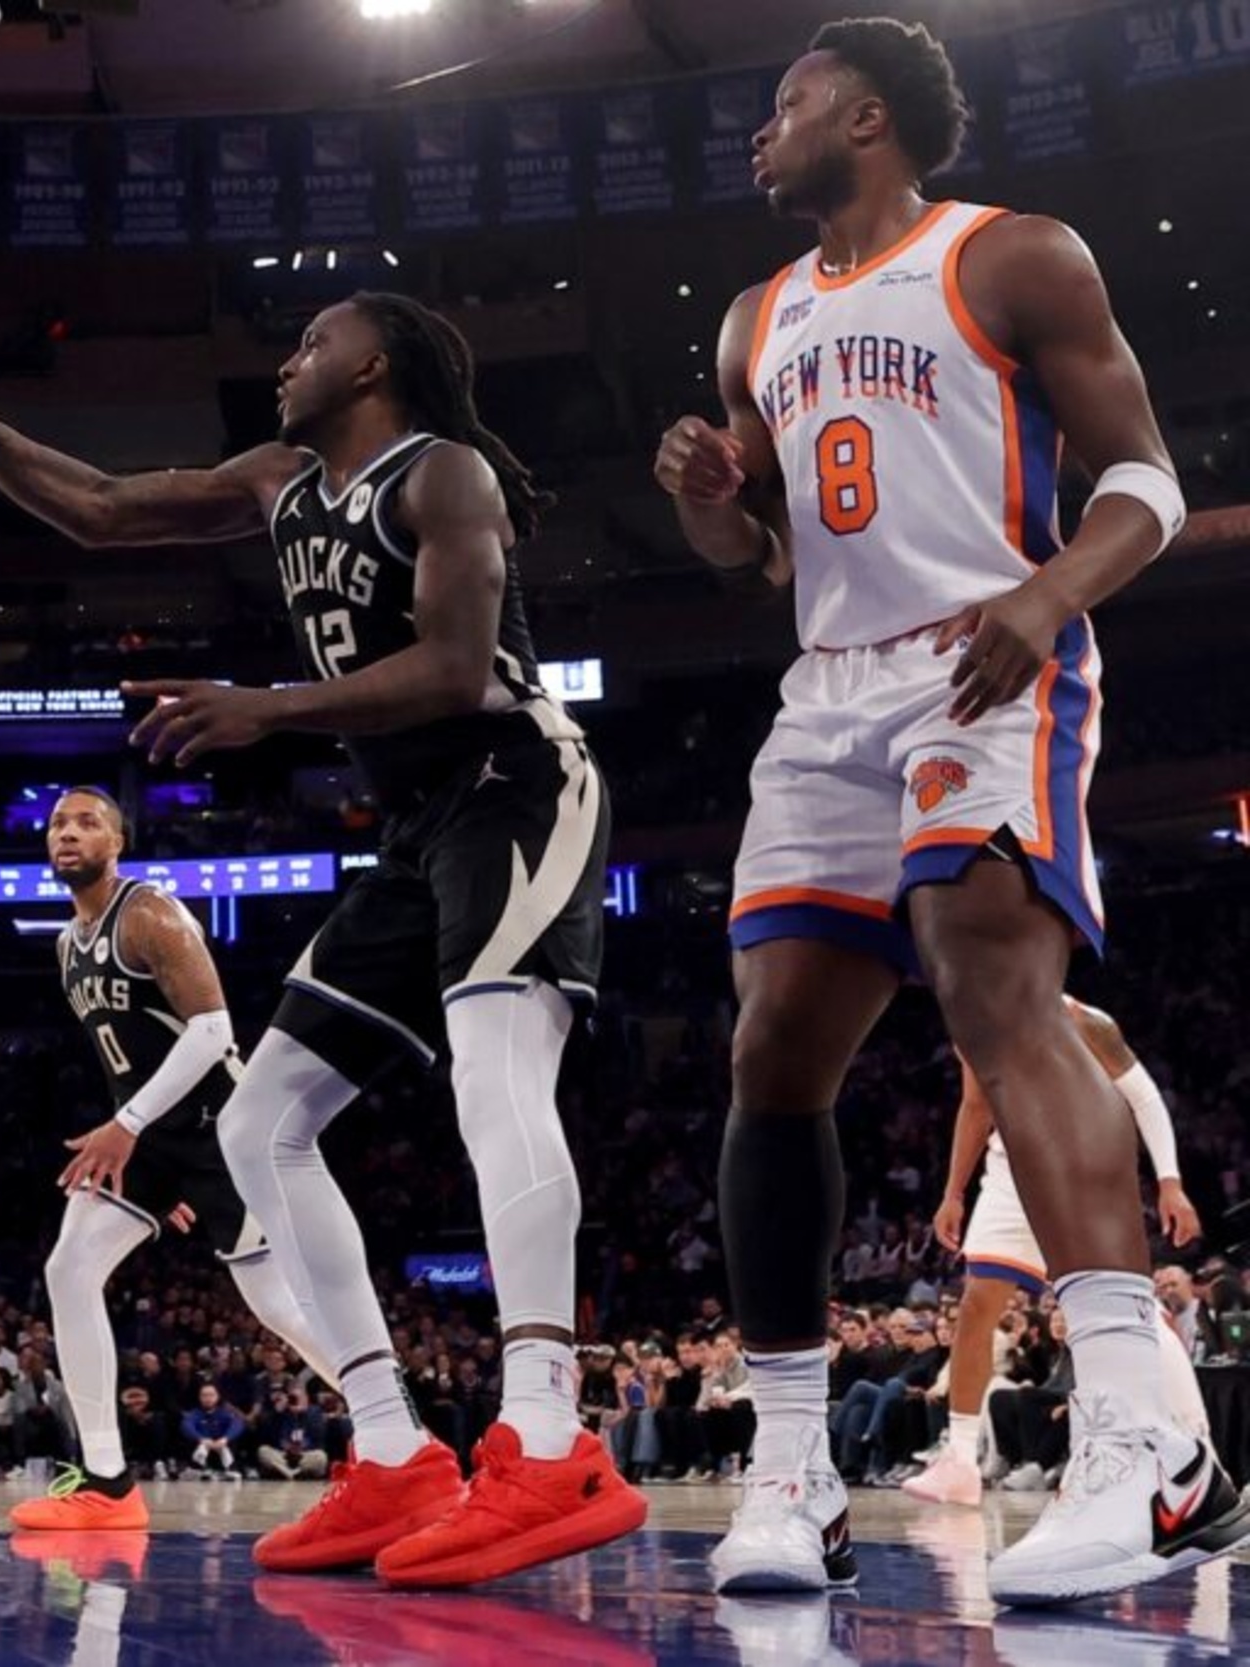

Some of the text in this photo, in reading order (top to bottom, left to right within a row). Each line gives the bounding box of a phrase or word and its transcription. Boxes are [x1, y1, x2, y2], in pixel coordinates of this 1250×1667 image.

[761, 336, 939, 438] NEW YORK
[816, 415, 878, 536] 8
[278, 535, 379, 606] UCKS
[304, 608, 357, 681] 12
[16, 701, 42, 712] NEW
[46, 701, 77, 711] YORK
[48, 690, 101, 700] PARTNER
[68, 975, 130, 1023] UCKS
[96, 1022, 132, 1075] 0
